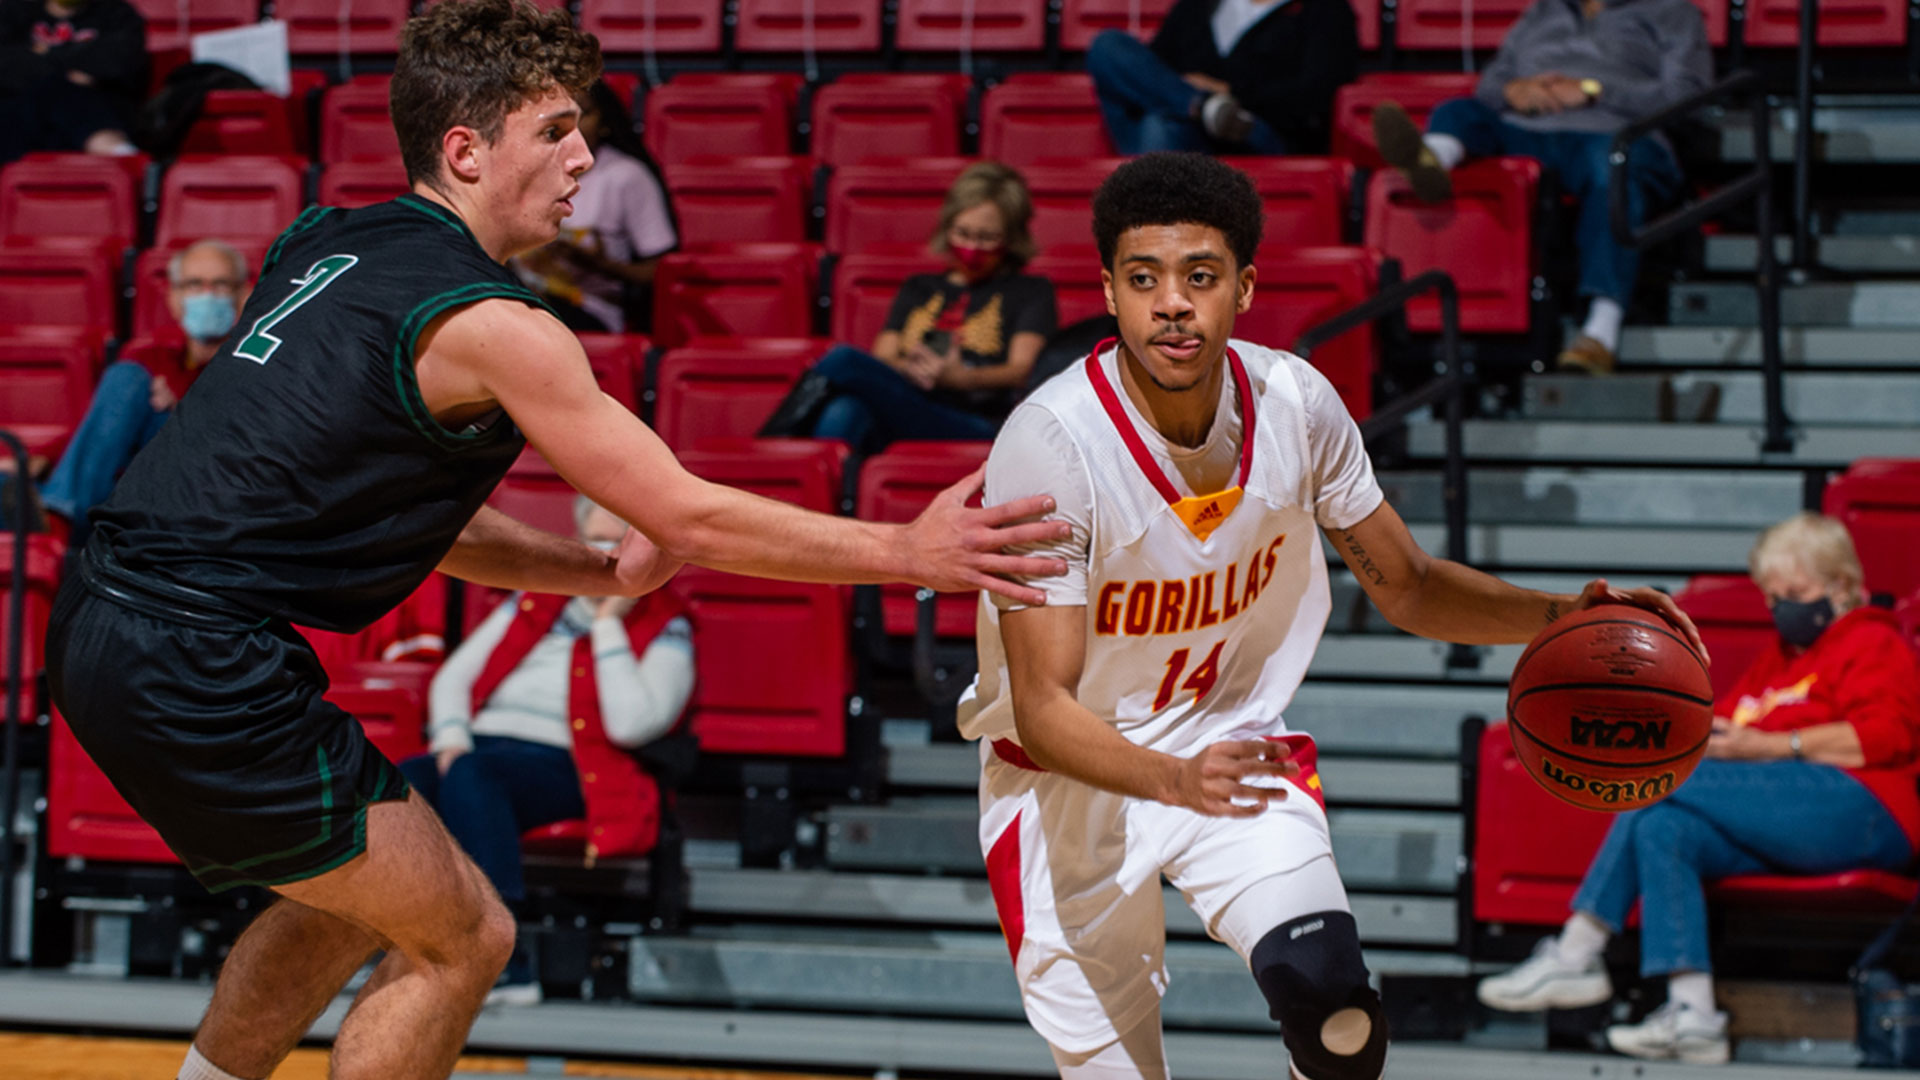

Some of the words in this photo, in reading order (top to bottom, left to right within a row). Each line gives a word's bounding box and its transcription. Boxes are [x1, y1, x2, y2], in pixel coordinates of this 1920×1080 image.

[232, 254, 359, 365] 2
[1095, 534, 1286, 636] GORILLAS
[1152, 639, 1227, 713] 14
[1570, 715, 1672, 750] NCAA
[1542, 757, 1675, 803] Wilson
